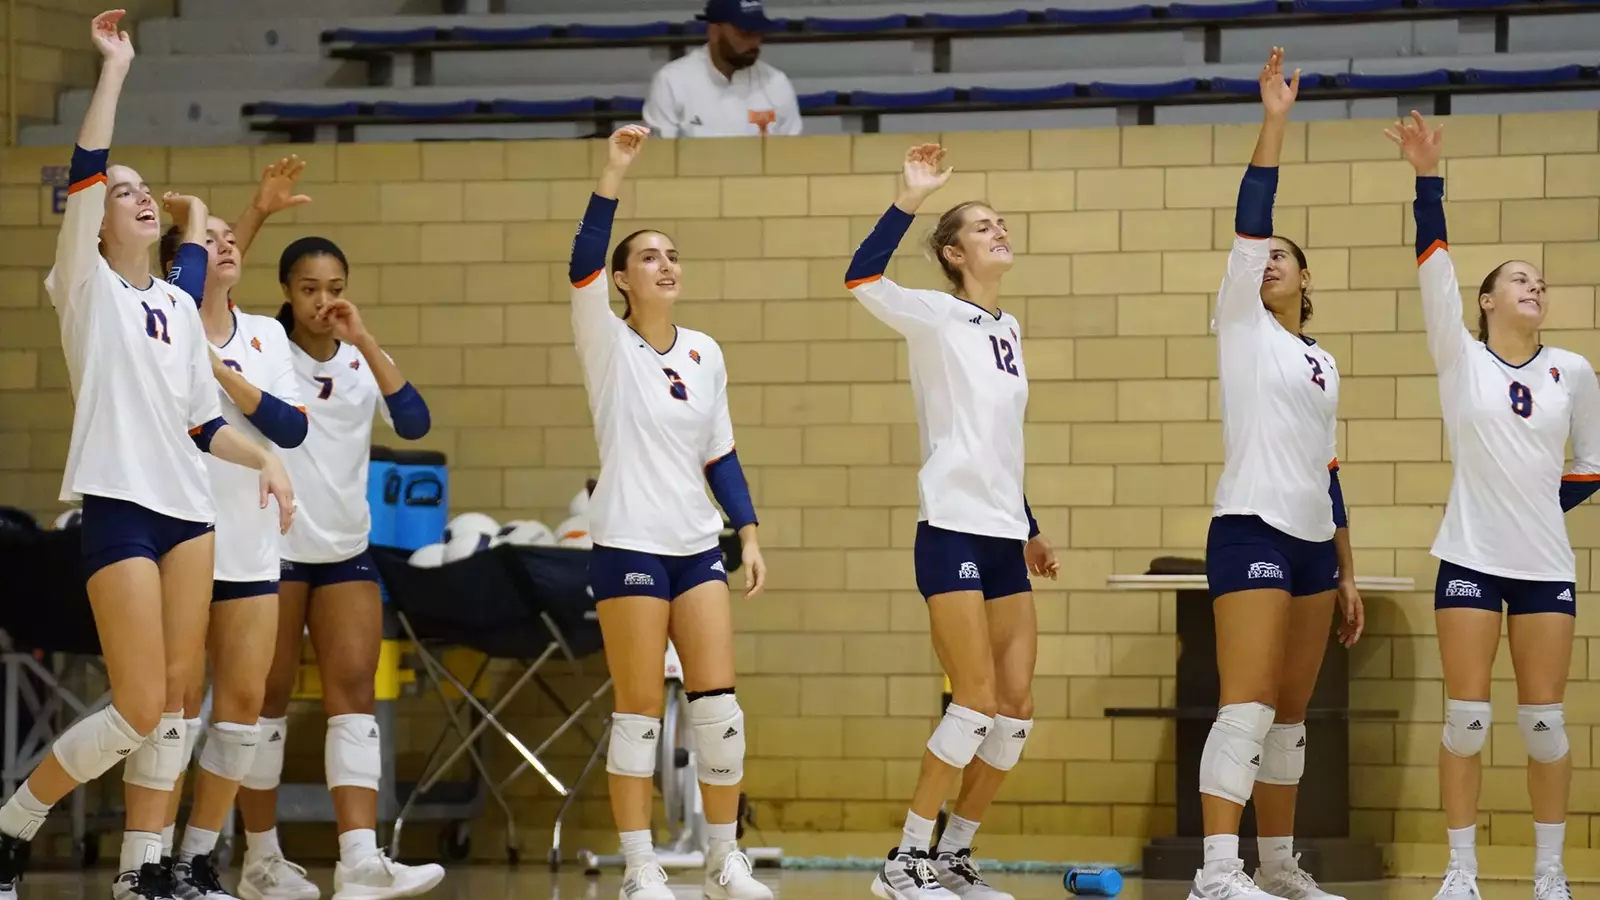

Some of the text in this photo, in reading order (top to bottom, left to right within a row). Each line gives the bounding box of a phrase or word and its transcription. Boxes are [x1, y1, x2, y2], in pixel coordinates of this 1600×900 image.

[988, 334, 1019, 377] 12
[1304, 353, 1325, 391] 2
[313, 375, 333, 400] 7
[661, 367, 688, 401] 6
